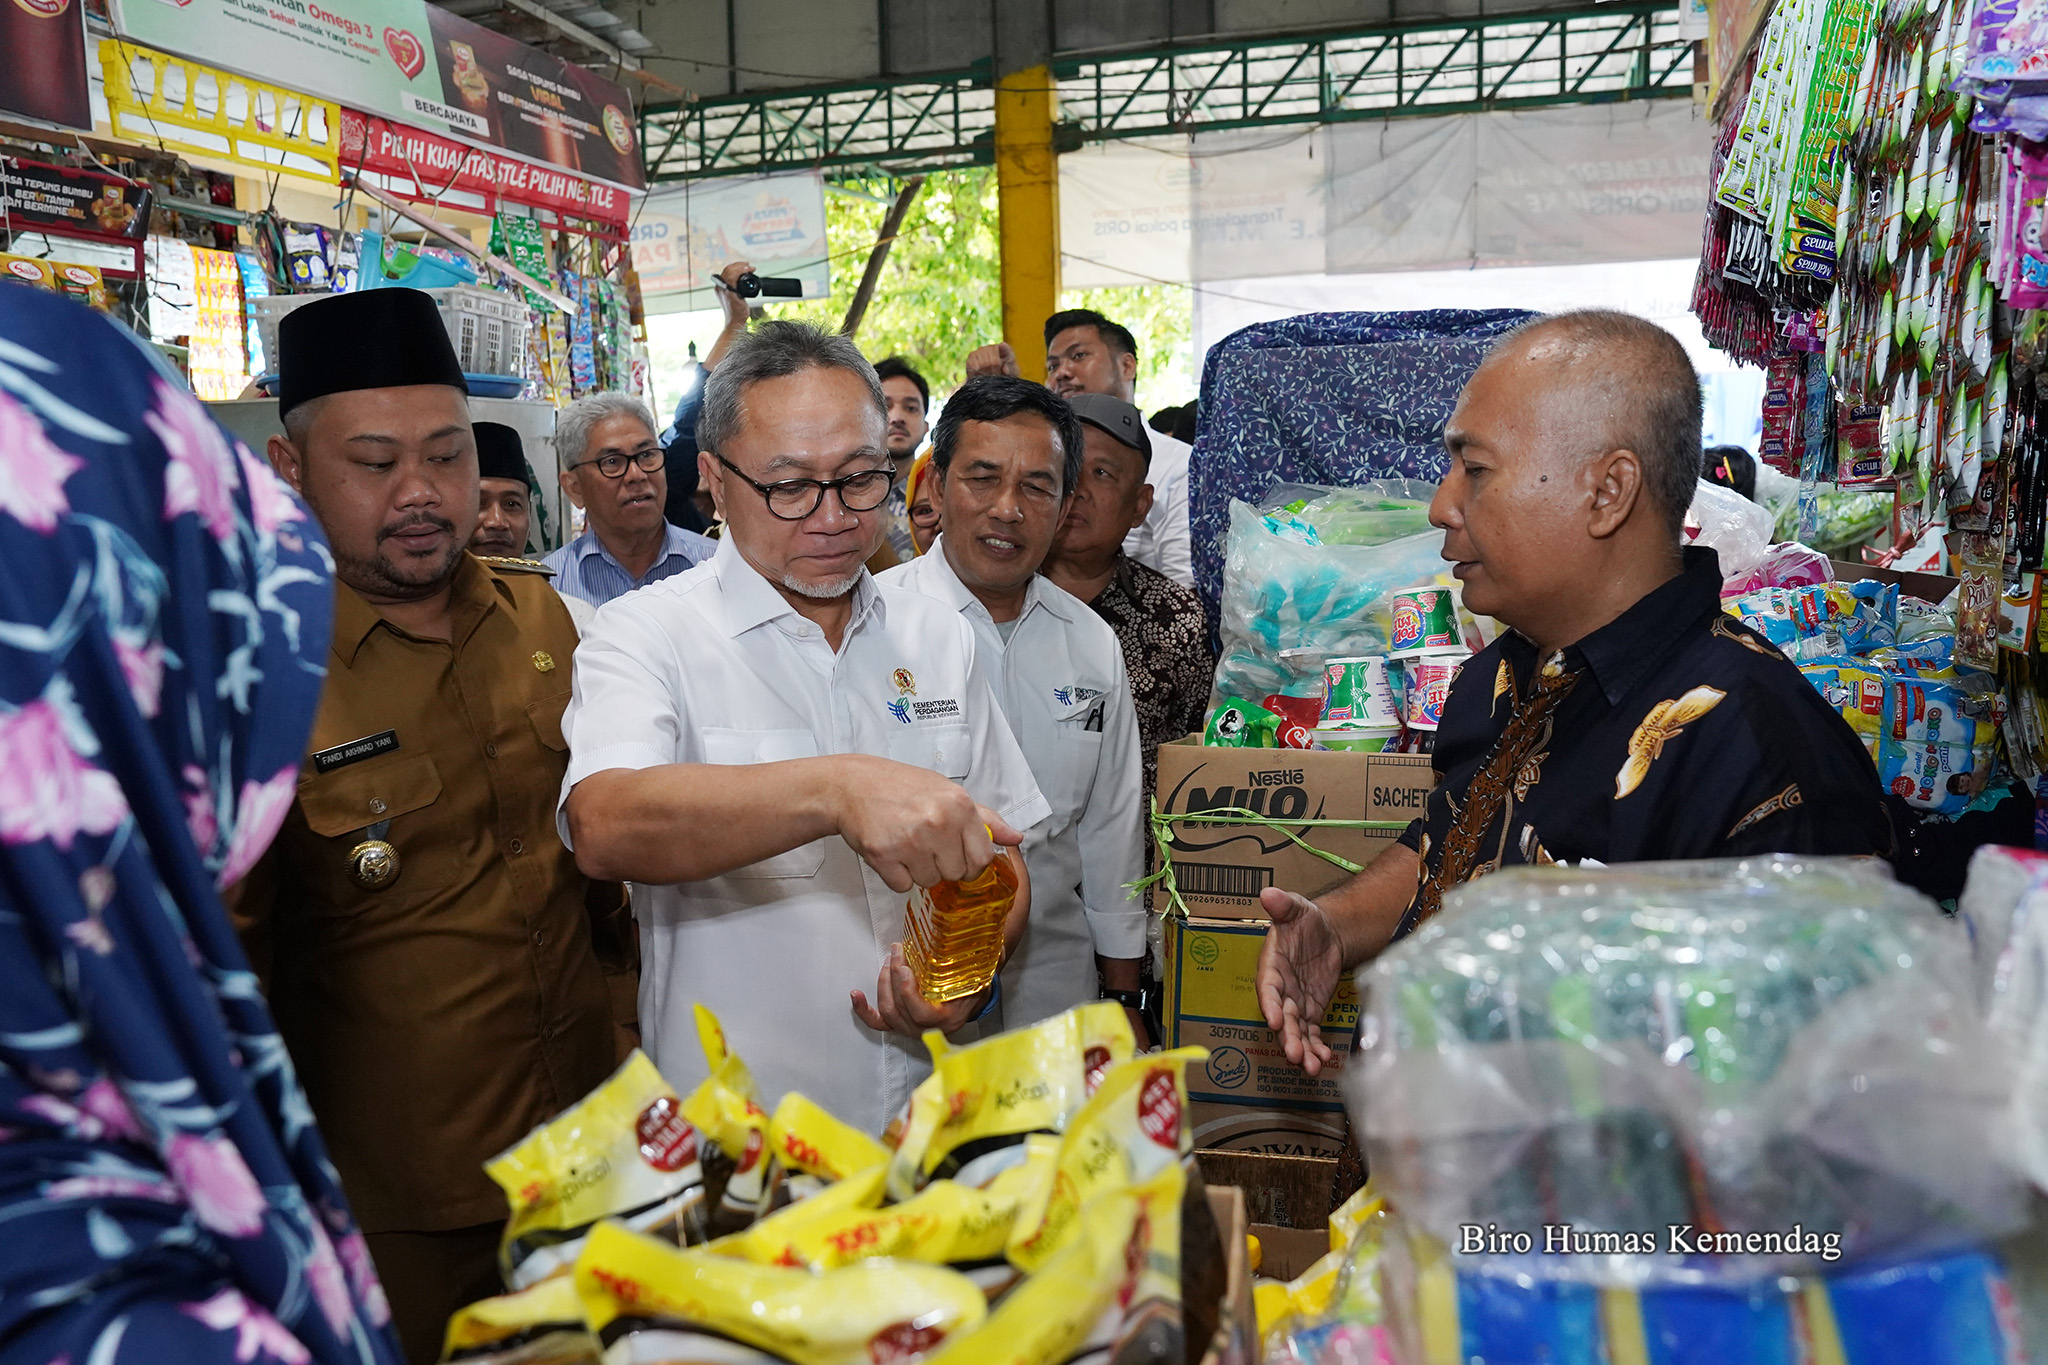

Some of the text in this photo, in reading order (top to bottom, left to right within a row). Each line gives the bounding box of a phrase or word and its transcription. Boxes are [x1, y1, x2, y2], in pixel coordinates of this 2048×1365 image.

[268, 9, 297, 27] Sehat
[297, 20, 324, 37] untuk
[324, 28, 347, 46] Yang
[308, 3, 362, 36] Omega
[363, 24, 374, 39] 3
[530, 84, 566, 111] VIRAL
[414, 98, 478, 130] BERCAHAYA
[380, 130, 425, 164] PILIH
[528, 168, 563, 197] PILIH
[24, 177, 61, 193] TEPUNG
[61, 184, 94, 199] BUMBU
[14, 188, 75, 208] BERVITAMIN
[23, 201, 87, 220] BERMINERAL
[1796, 257, 1832, 277] Marimas
[1982, 487, 1993, 498] 15
[1991, 523, 2003, 535] 30
[1392, 615, 1412, 634] MIE
[1394, 624, 1419, 643] POP
[1986, 628, 1996, 638] 30
[912, 698, 957, 709] KEMENTERIAN
[1864, 680, 1878, 708] L 3
[914, 704, 959, 716] PERDAGANGAN
[321, 736, 392, 765] FANDI AKHMAD YANI
[1248, 768, 1304, 787] Nestlé
[1917, 755, 1940, 801] MOKO
[1183, 785, 1309, 830] MILO
[1331, 1002, 1360, 1014] PEN
[1209, 1025, 1274, 1043] 3097006 D
[1245, 1047, 1270, 1057] PANAS
[1213, 1049, 1246, 1082] Sinde
[1256, 1084, 1272, 1093] ISO
[1316, 1088, 1331, 1097] ISO
[1257, 1075, 1340, 1089] PT. SINDE BUDI SEN
